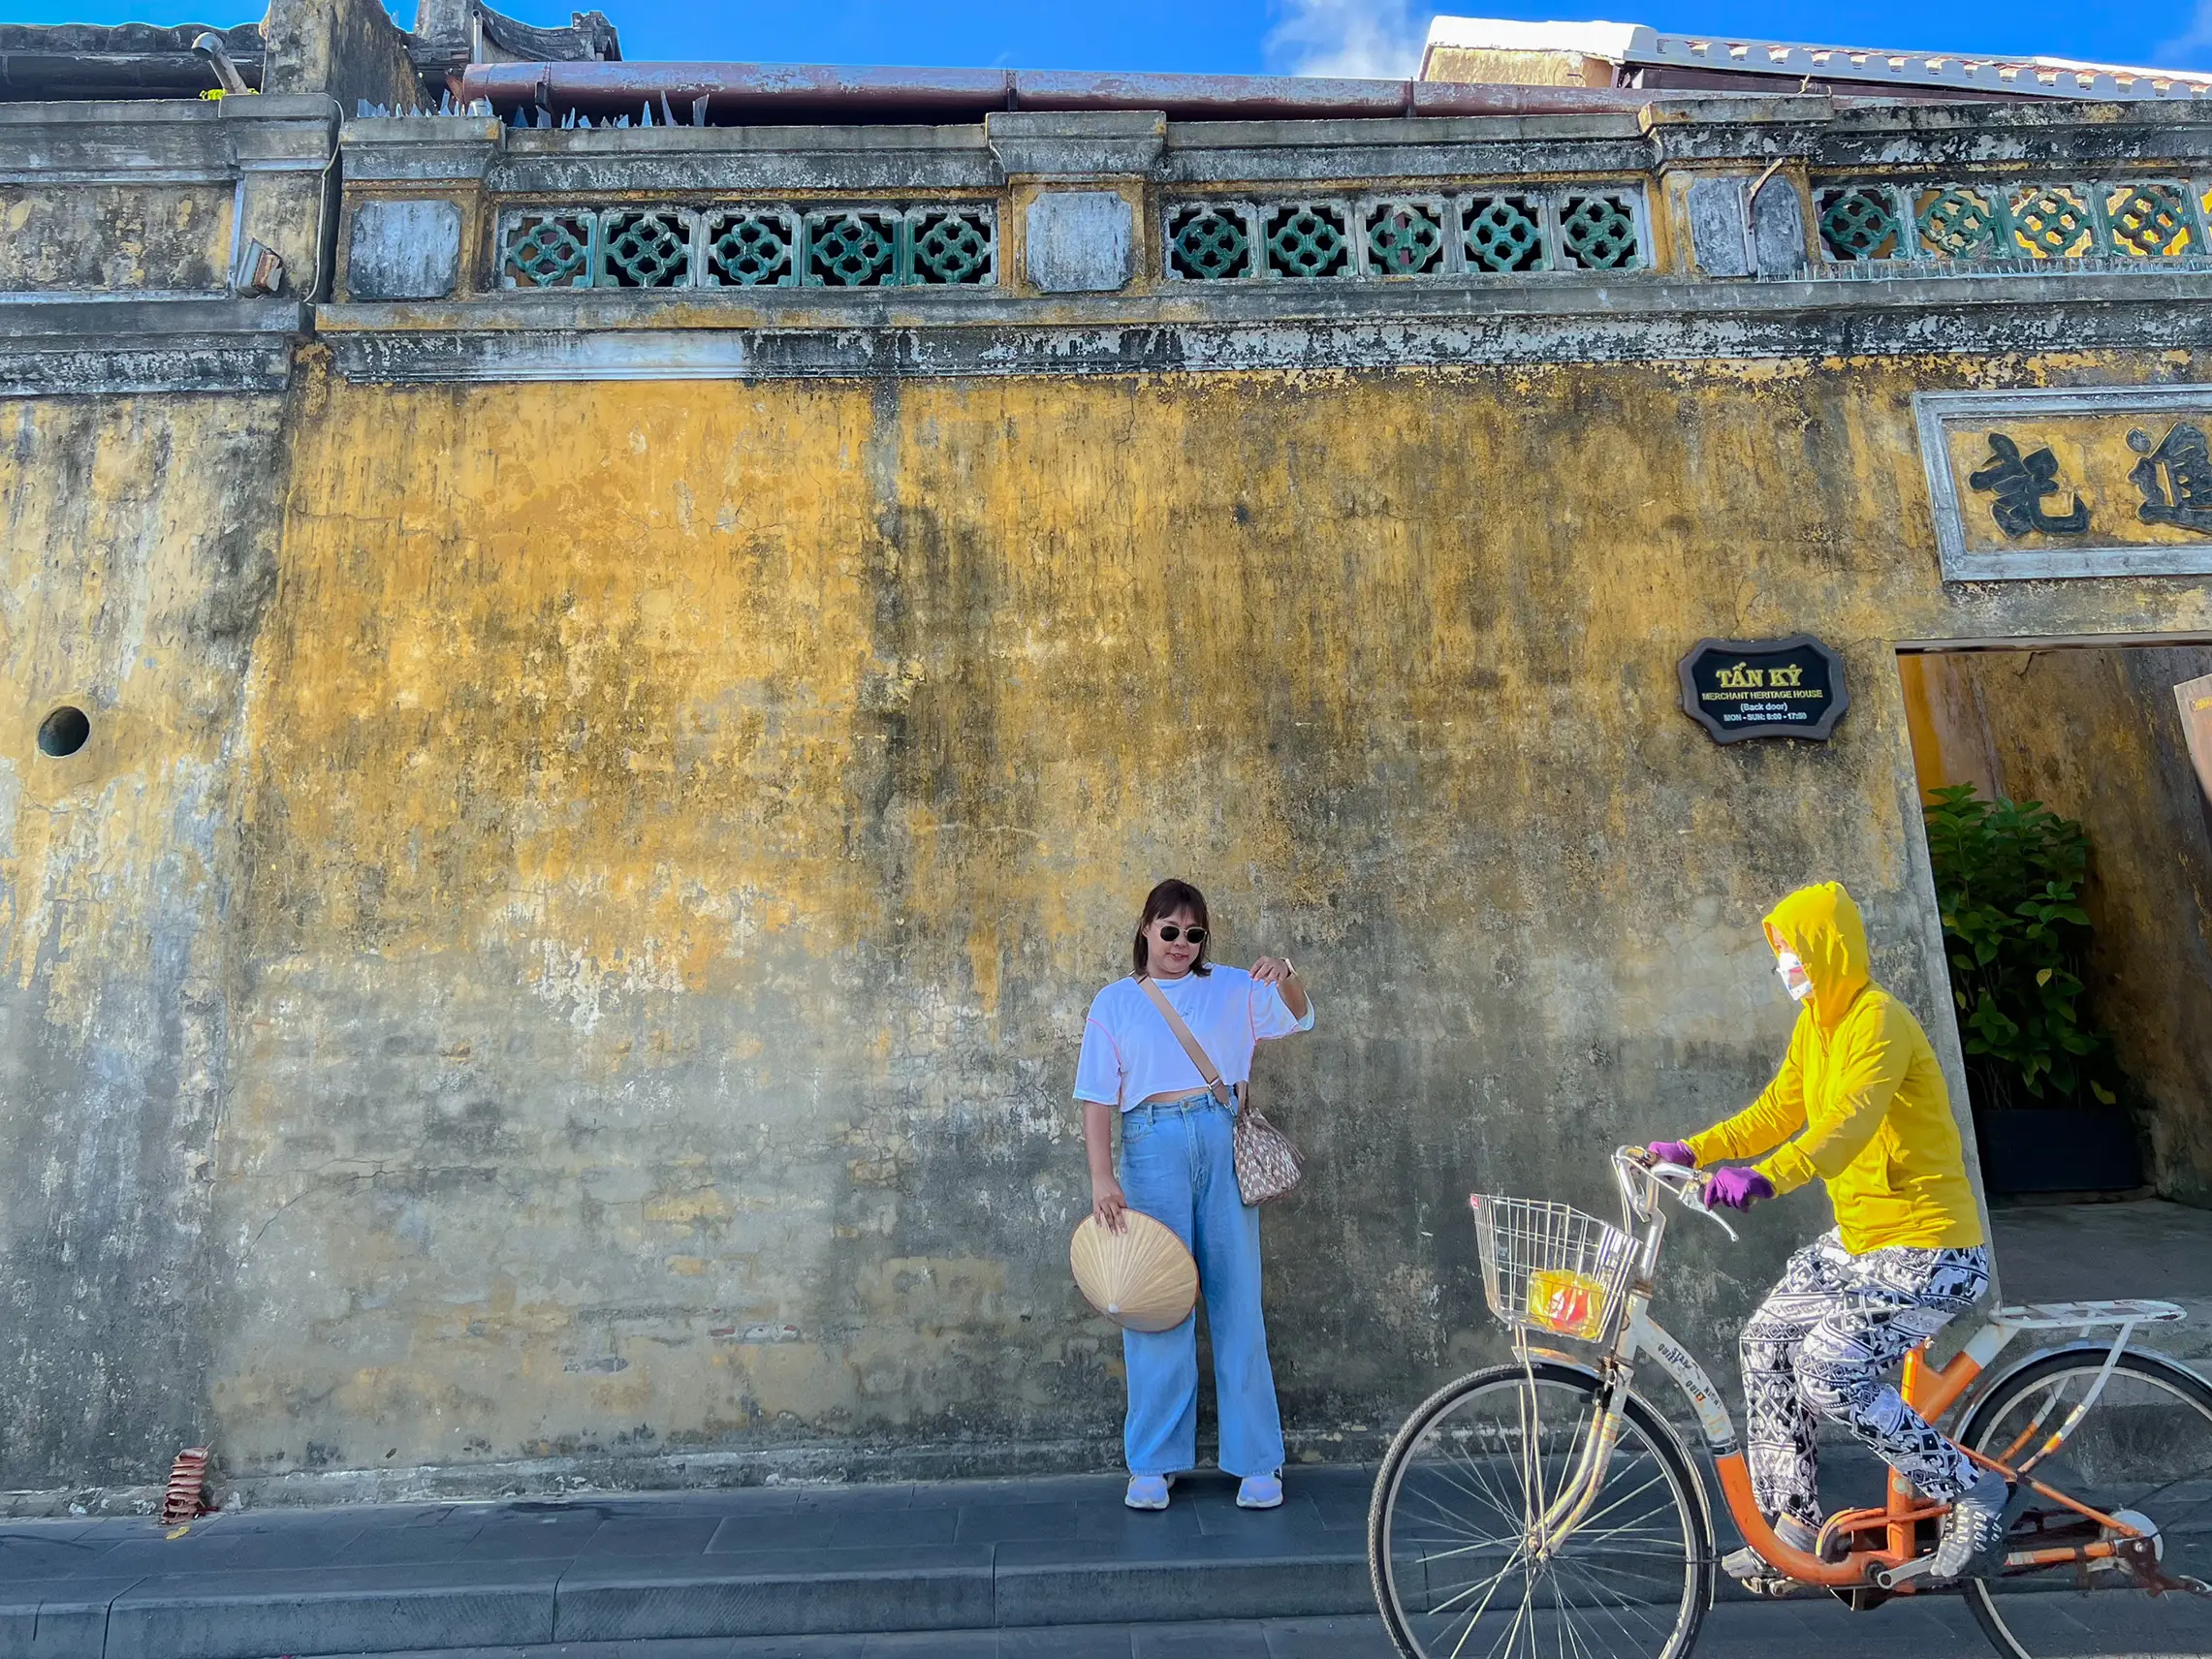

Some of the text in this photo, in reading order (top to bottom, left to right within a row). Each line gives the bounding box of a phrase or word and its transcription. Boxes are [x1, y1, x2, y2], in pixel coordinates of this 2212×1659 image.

[1716, 662, 1802, 688] TẤN KÝ
[1702, 692, 1749, 701] MERCHANT
[1793, 689, 1823, 698] HOUSE
[1740, 702, 1787, 712] (Back door)
